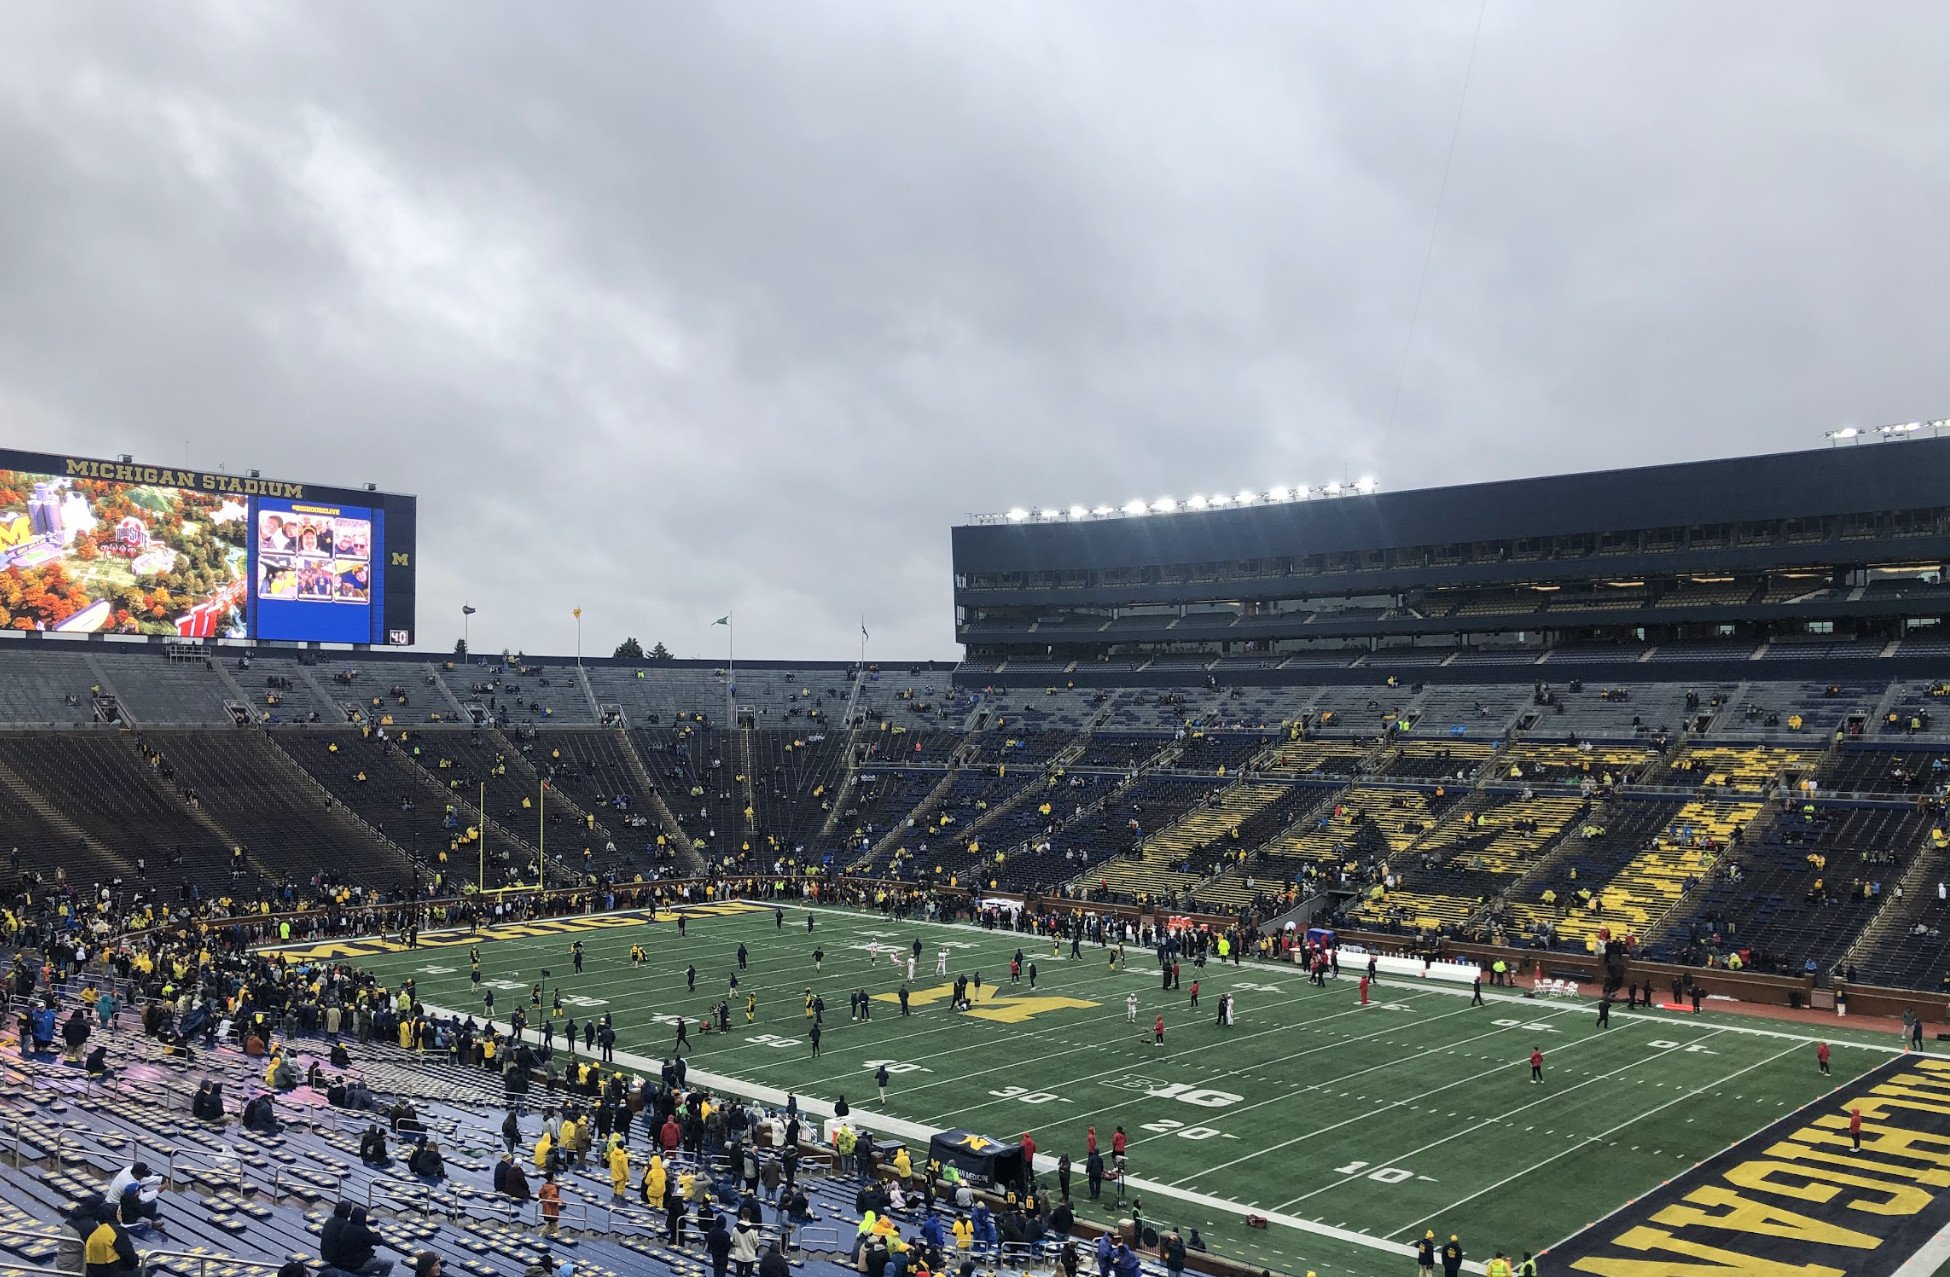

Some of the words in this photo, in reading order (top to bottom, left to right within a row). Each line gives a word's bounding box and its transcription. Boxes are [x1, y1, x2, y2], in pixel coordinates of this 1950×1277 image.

[66, 459, 195, 487] MICHIGAN
[202, 474, 303, 499] STADIUM
[391, 552, 409, 567] M
[390, 632, 407, 643] 40
[257, 902, 777, 964] MICHIGAN
[744, 1033, 803, 1048] 50
[988, 1085, 1059, 1104] 30
[1139, 1118, 1221, 1140] 20
[1333, 1160, 1414, 1184] 10
